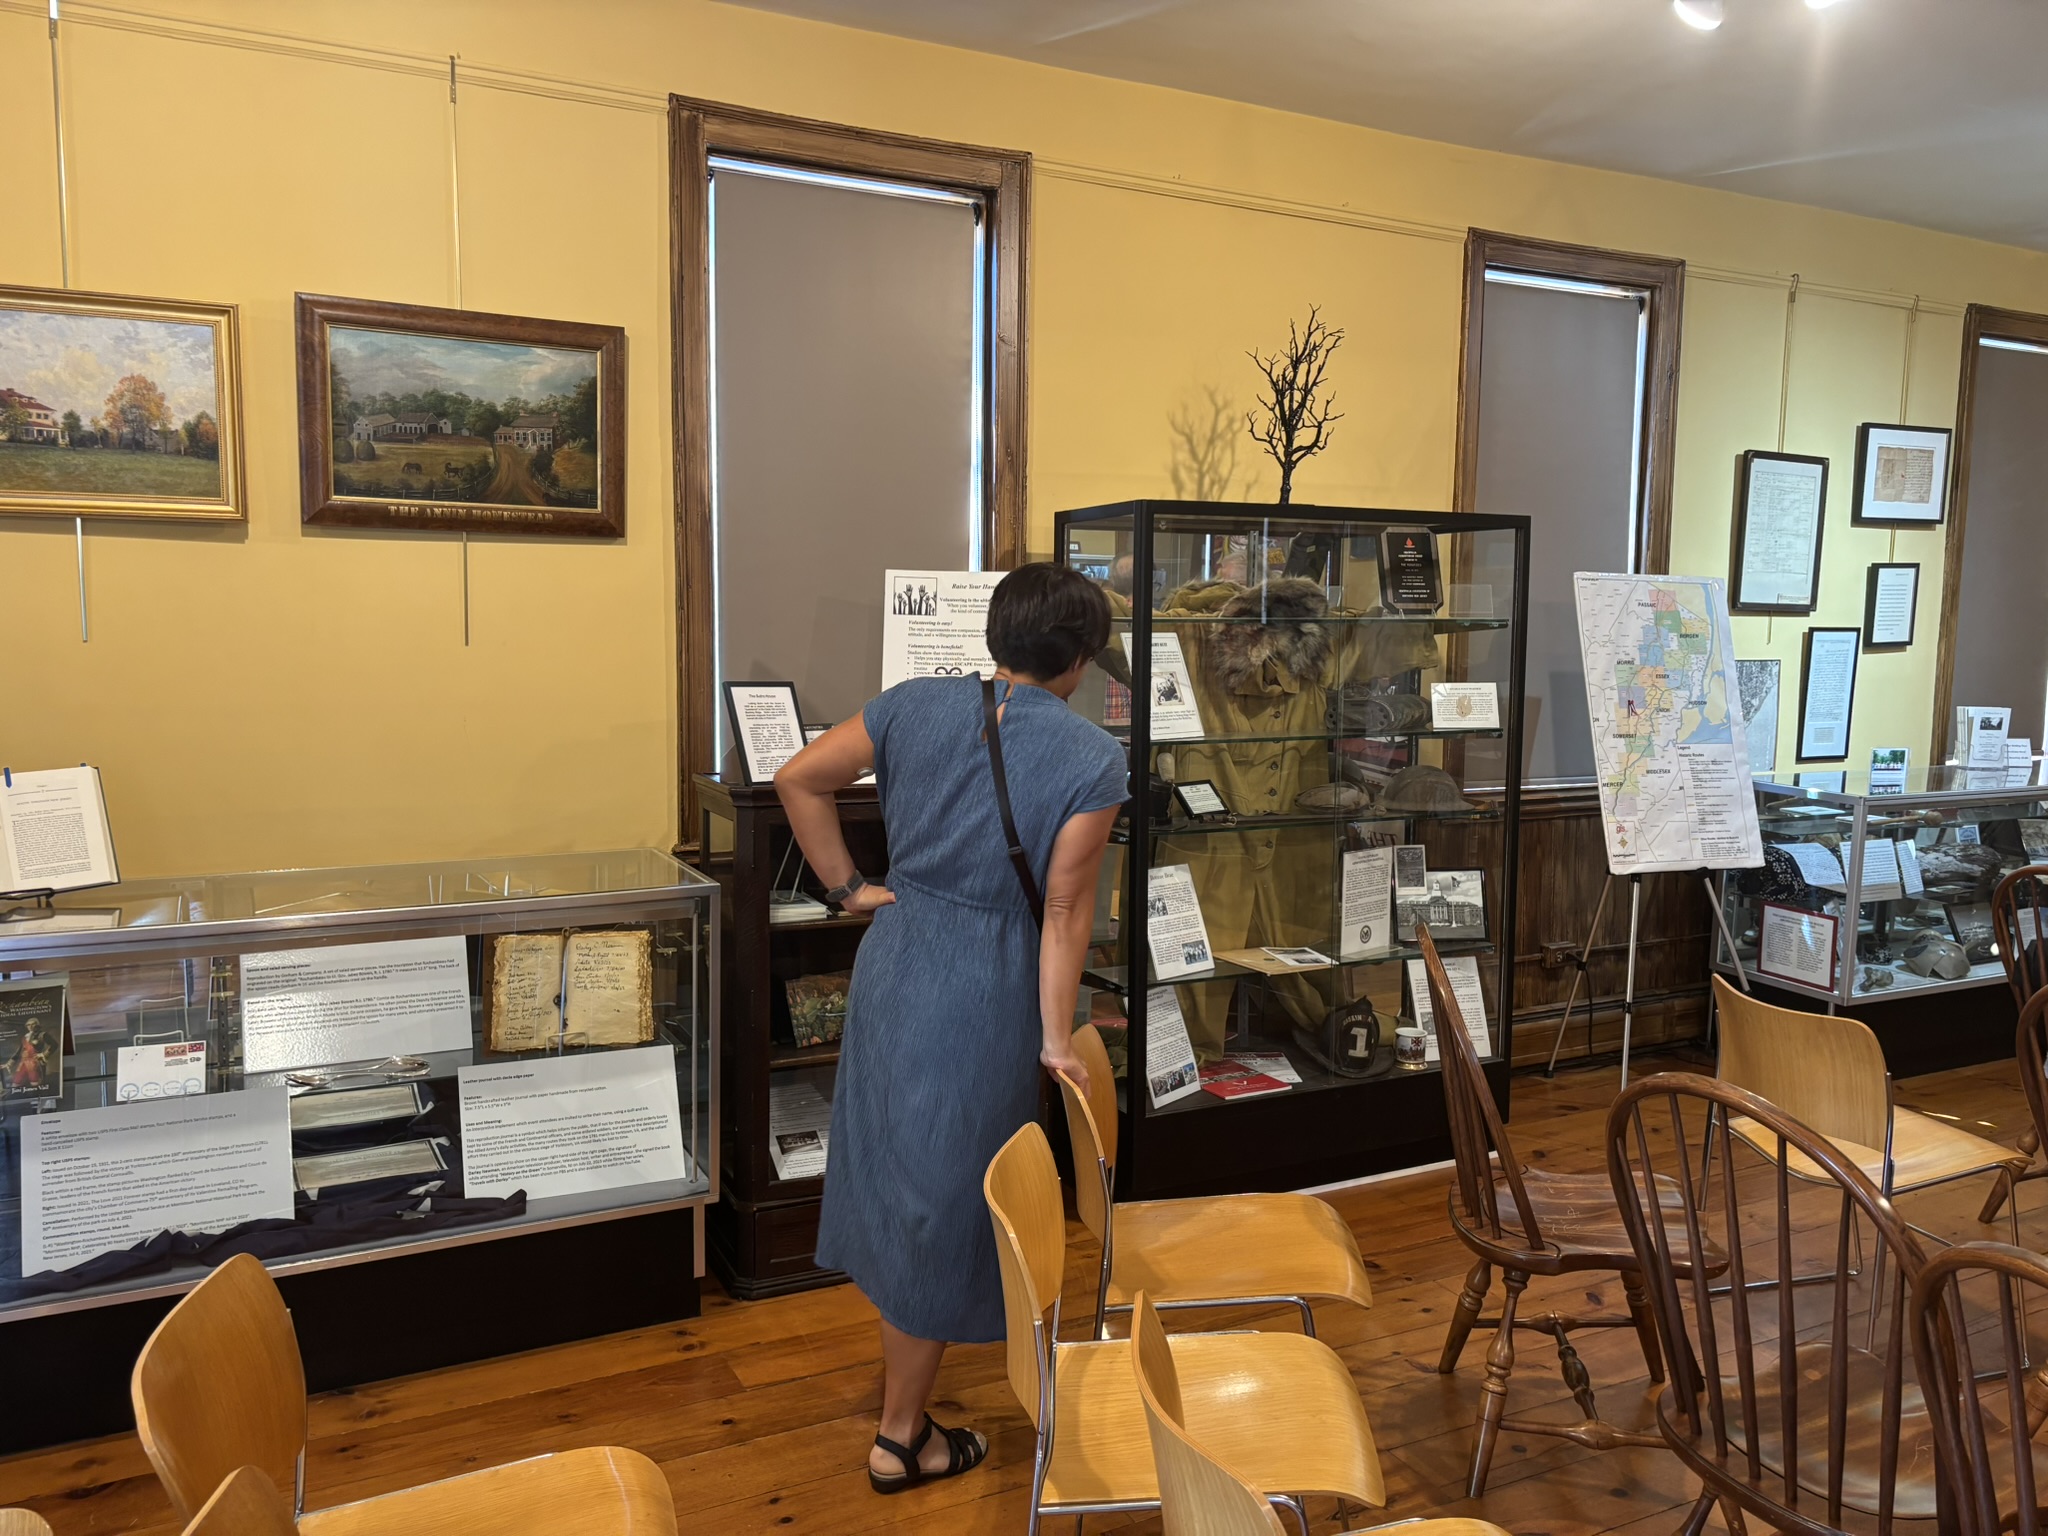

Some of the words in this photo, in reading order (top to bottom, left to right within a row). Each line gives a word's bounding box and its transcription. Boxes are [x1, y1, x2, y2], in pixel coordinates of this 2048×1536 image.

[388, 506, 419, 517] THE
[425, 507, 468, 519] ANNIN
[473, 510, 557, 524] HOMESTEAD
[1348, 1027, 1369, 1057] 1
